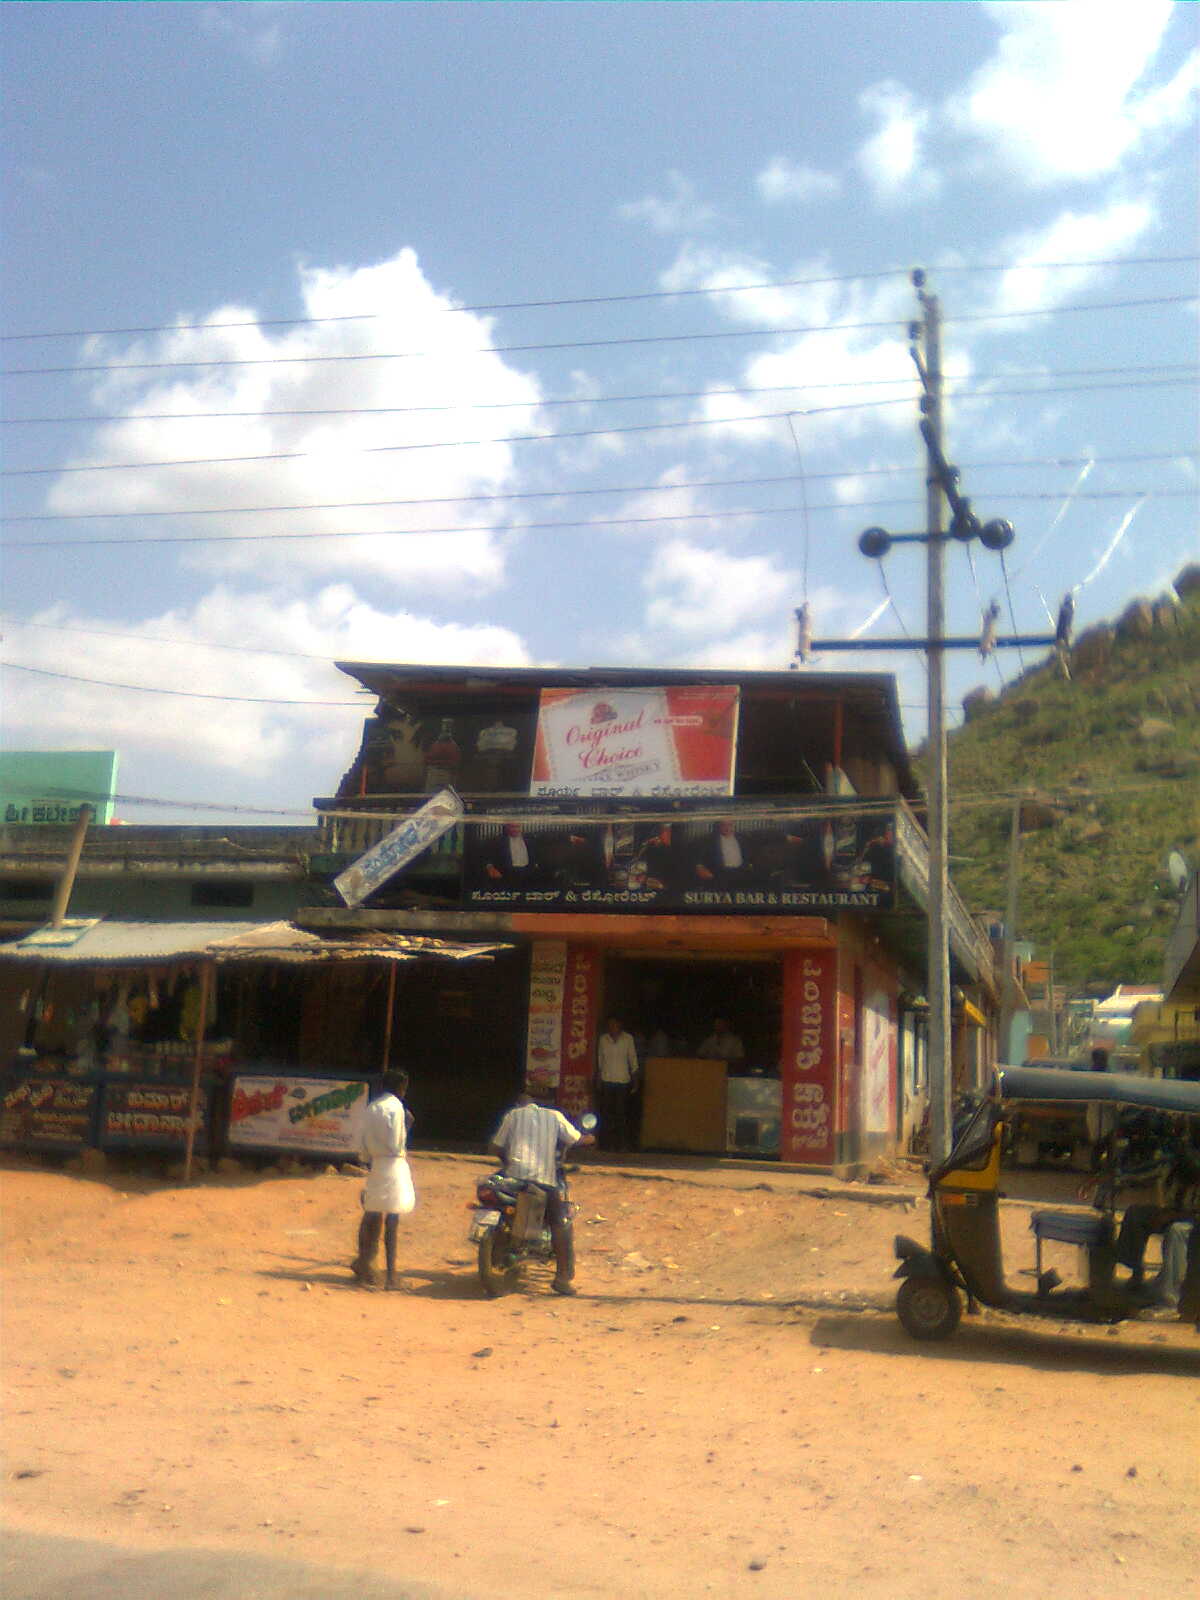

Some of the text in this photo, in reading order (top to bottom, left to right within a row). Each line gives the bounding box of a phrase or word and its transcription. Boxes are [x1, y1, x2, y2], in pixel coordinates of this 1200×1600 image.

[565, 709, 645, 749] Original
[578, 746, 642, 769] Choice
[565, 890, 577, 902] &
[684, 890, 880, 907] SURYA BAR & RESTAURANT
